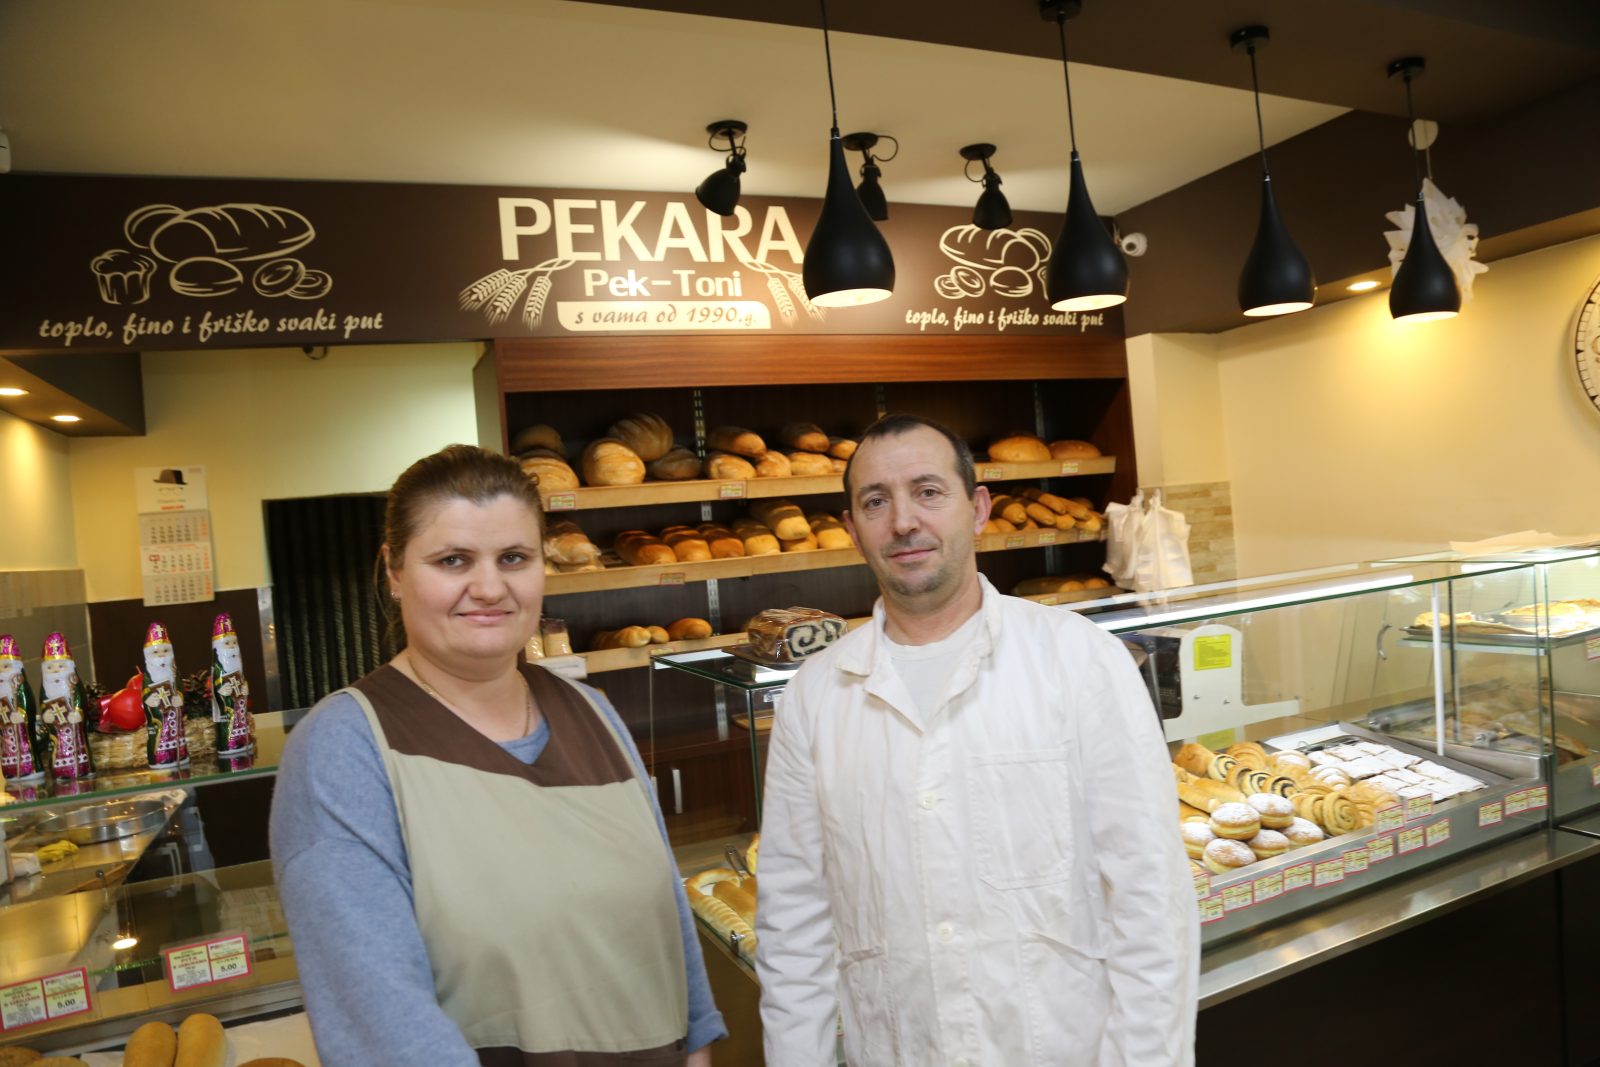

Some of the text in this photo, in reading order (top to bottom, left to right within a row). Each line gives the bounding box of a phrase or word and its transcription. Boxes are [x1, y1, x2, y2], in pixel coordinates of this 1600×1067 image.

[498, 197, 805, 264] PEKARA
[39, 308, 383, 347] toplo, fino i friško svaki put
[575, 312, 584, 325] s
[592, 311, 647, 324] vama
[656, 304, 677, 323] od
[905, 306, 1104, 332] toplo, fino i friško svaki put
